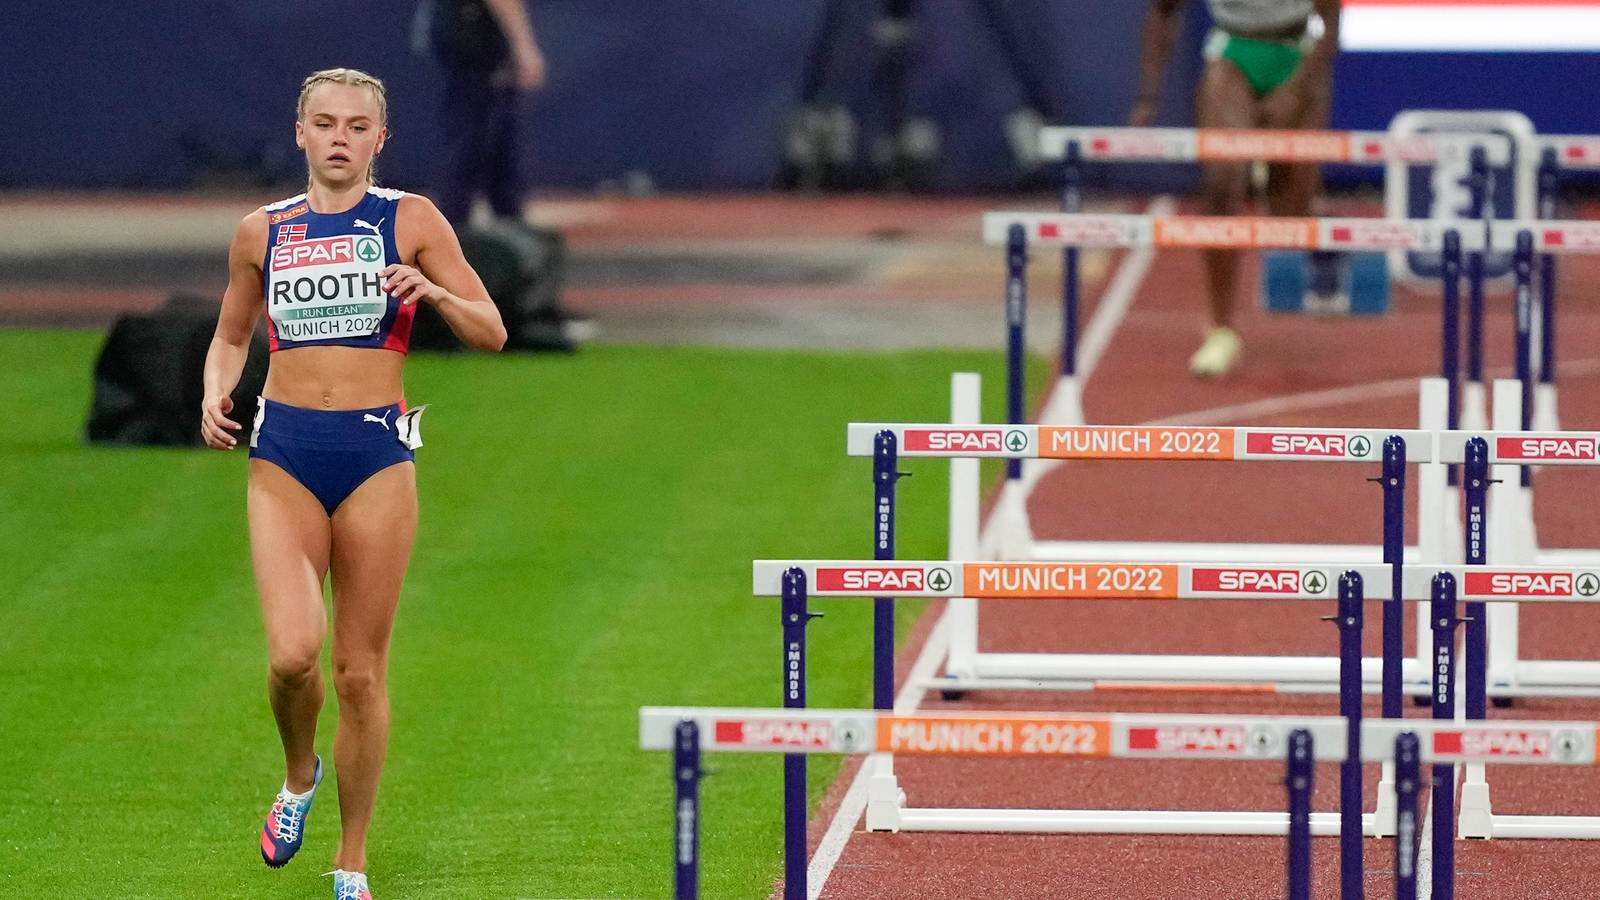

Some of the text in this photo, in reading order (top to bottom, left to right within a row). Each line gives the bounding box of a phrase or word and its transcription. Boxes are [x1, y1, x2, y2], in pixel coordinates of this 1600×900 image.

[273, 240, 352, 268] SPAR
[273, 272, 382, 305] ROOTH
[296, 310, 300, 319] I
[302, 308, 324, 318] RUN
[281, 317, 380, 337] MUNICH 2022
[928, 432, 1002, 450] SPAR
[1051, 430, 1221, 453] MUNICH 2022
[1271, 435, 1344, 455] SPAR
[1521, 440, 1594, 459] SPAR
[878, 505, 890, 549] MONDO
[1470, 513, 1481, 559] MONDO
[842, 570, 923, 589] SPAR
[978, 567, 1163, 592] MUNICH 2022
[1218, 571, 1298, 591] SPAR
[1491, 573, 1572, 593] SPAR
[788, 651, 800, 700] MONDO
[1437, 655, 1450, 704] MONDO
[890, 722, 1098, 753] MUNICH 2022
